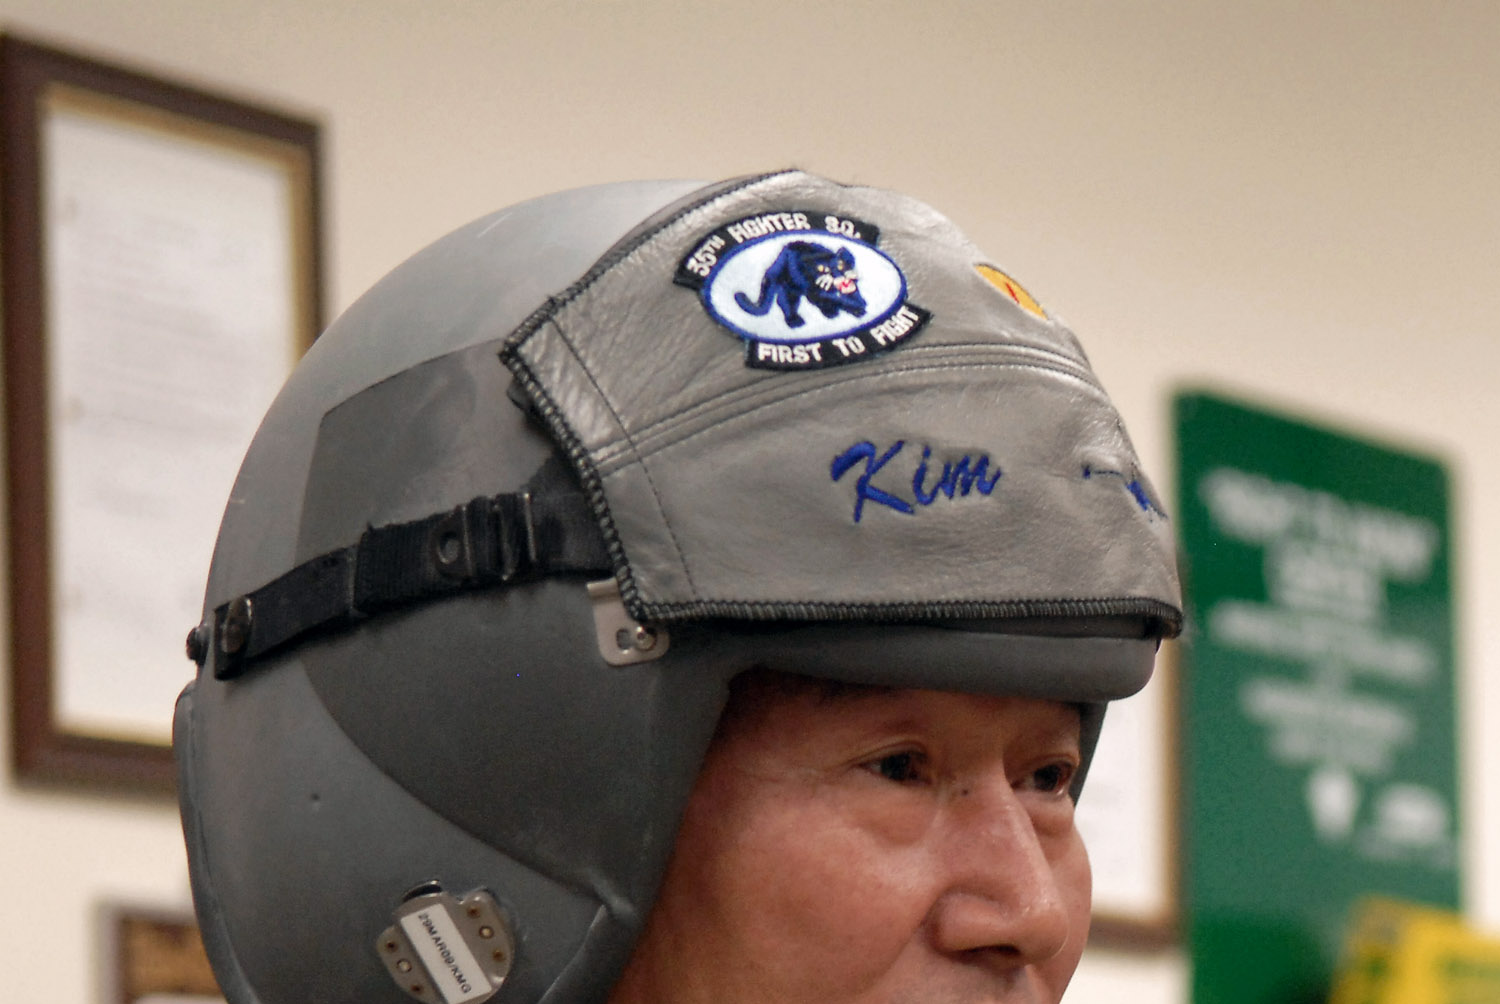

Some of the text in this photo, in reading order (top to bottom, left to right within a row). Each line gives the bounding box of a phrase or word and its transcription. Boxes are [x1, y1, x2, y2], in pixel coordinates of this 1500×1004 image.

[686, 235, 726, 277] 35TH
[727, 212, 811, 244] FIGHTER
[757, 305, 919, 363] FIRST TO FIGHT
[830, 440, 1003, 524] Kim
